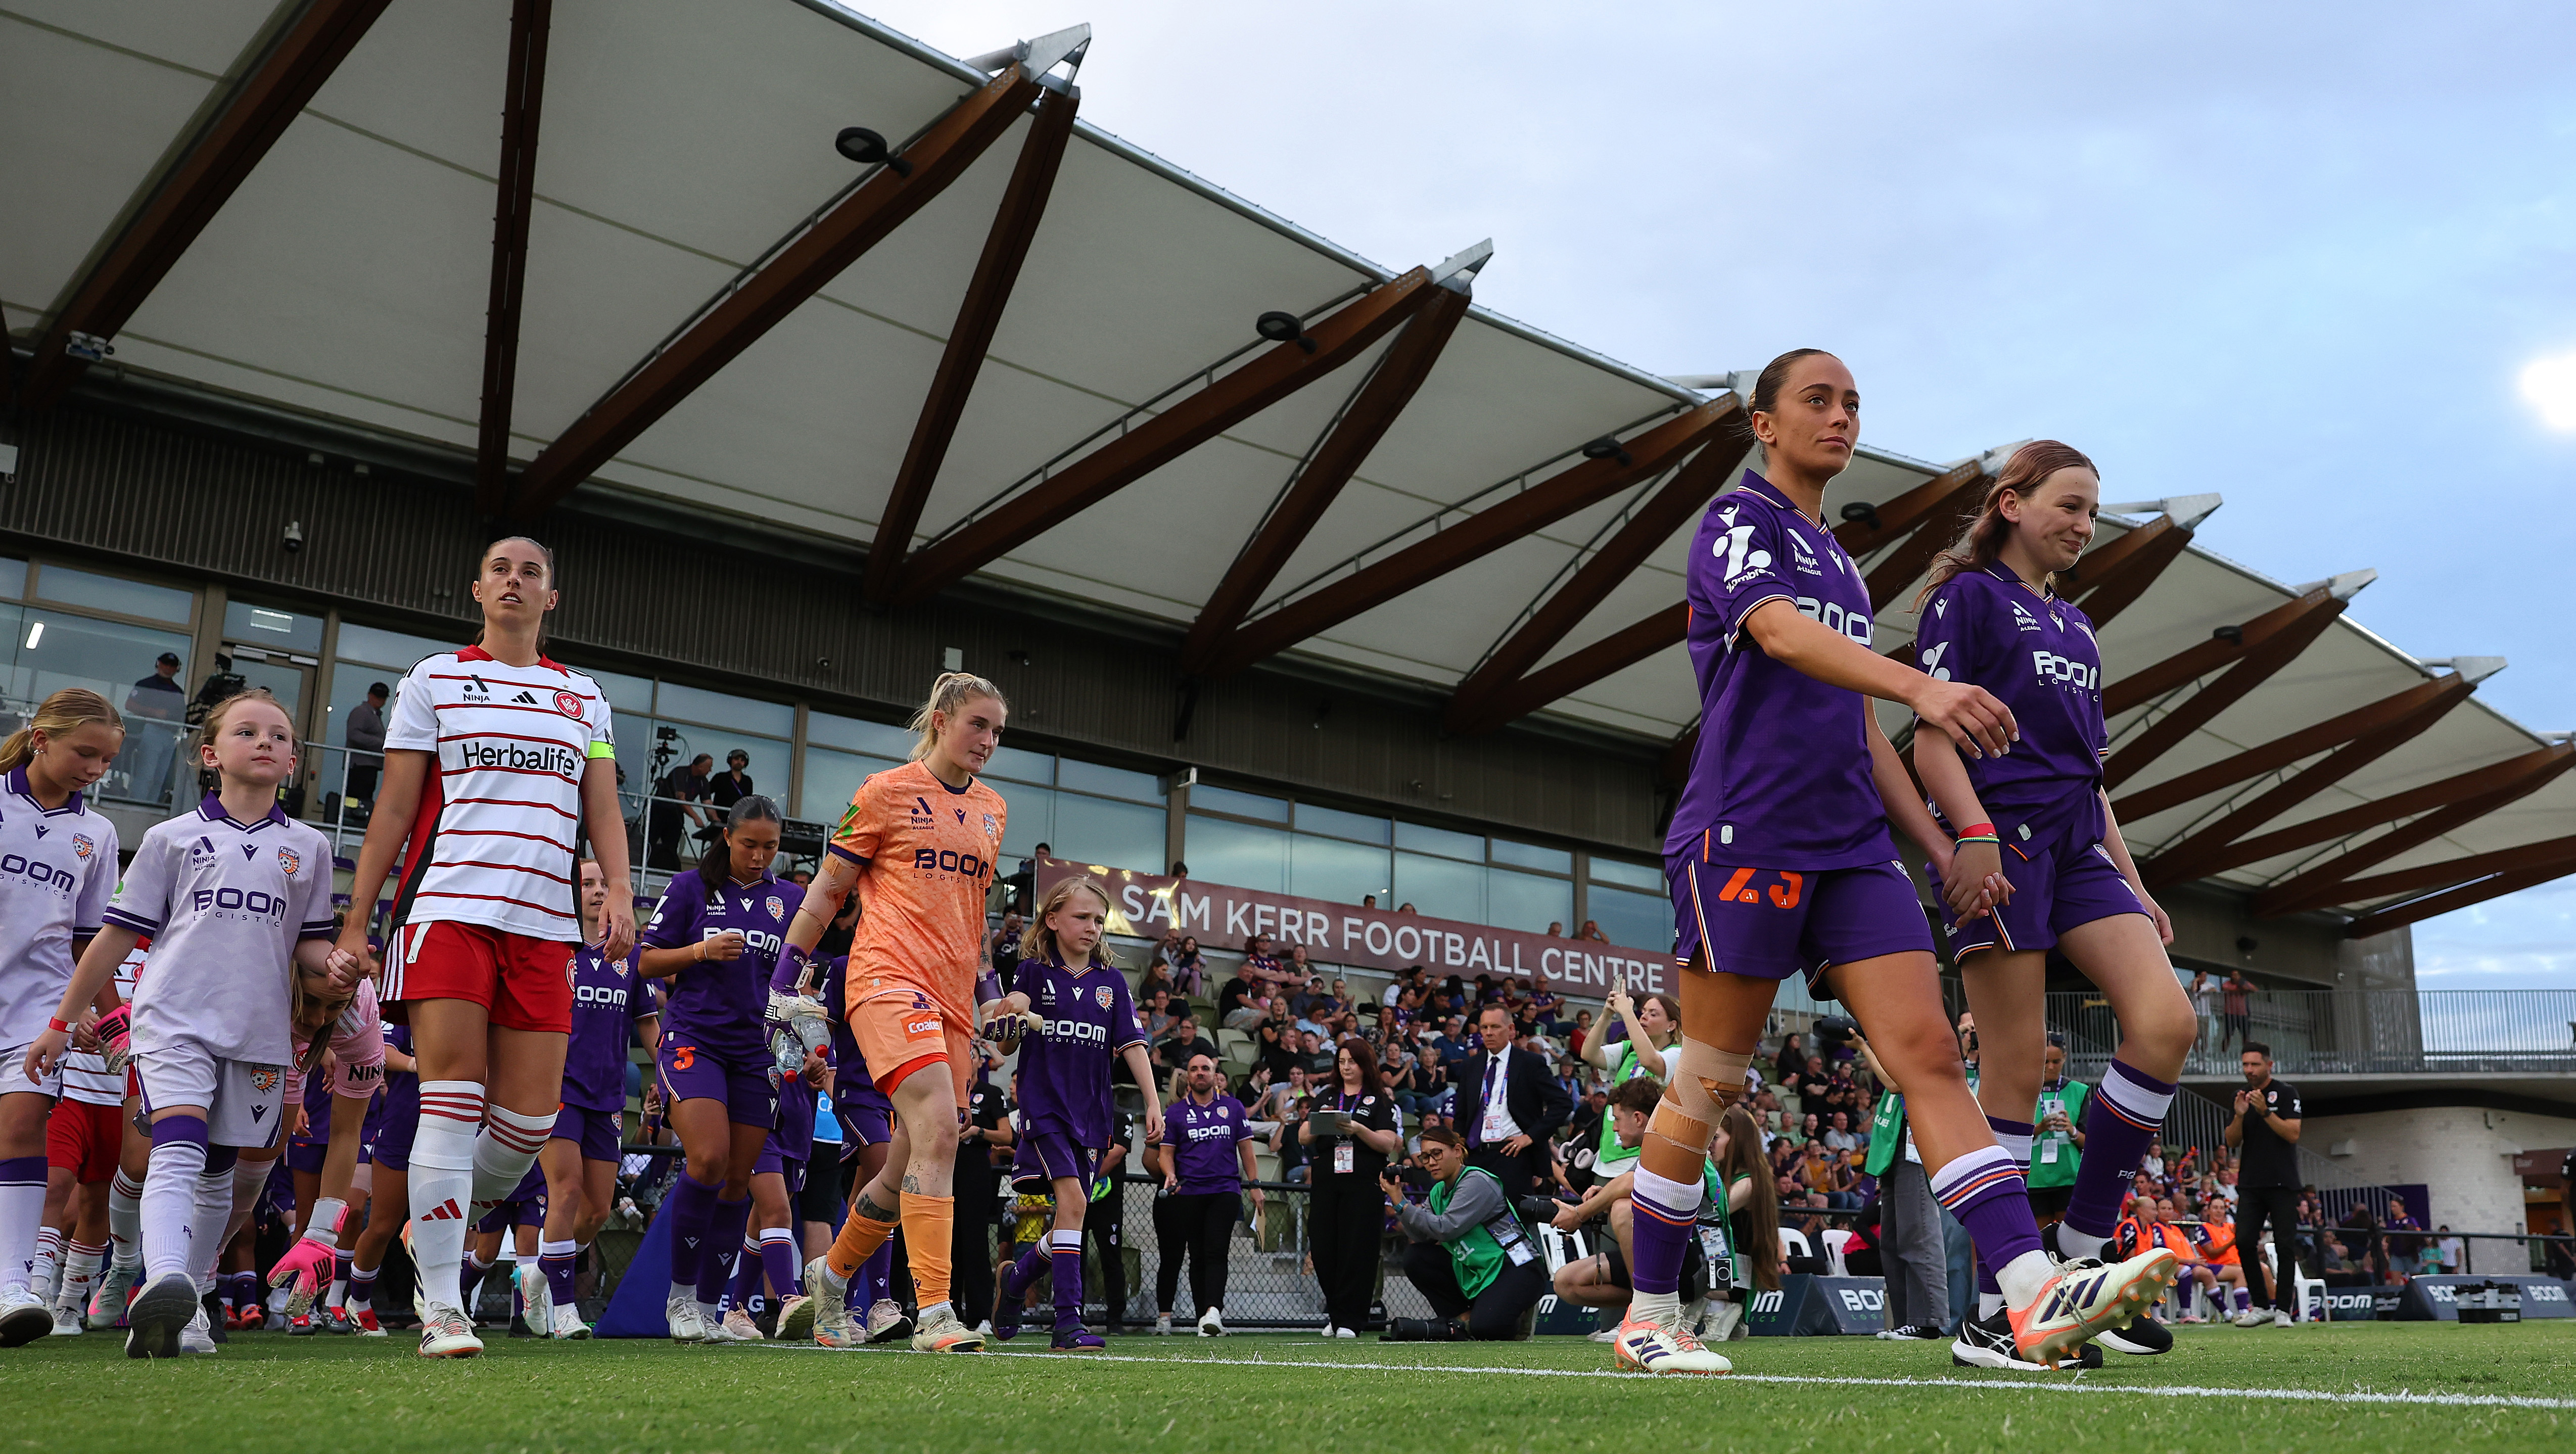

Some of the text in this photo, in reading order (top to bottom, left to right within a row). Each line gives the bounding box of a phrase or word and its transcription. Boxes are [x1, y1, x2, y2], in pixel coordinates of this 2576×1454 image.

[1797, 565, 1822, 577] A-LEAGUE
[2015, 617, 2038, 626] NINJA
[2038, 678, 2098, 702] LOISTIC
[463, 693, 491, 703] NINJA
[462, 742, 575, 776] Herbalife
[911, 816, 934, 825] NINJA
[192, 855, 216, 866] NINJA
[0, 854, 75, 893] OOM
[0, 874, 67, 900] GISTICS
[193, 887, 286, 921] BOOM
[193, 912, 280, 927] LOGISTIC
[1122, 884, 1665, 994] SAM KERR FOOTBALL CENTRE
[576, 985, 627, 1006] OOM
[577, 1002, 625, 1012] GISTICS
[908, 1019, 941, 1034] Coates
[1042, 1019, 1107, 1043] BOOM
[1048, 1038, 1104, 1050] OGISTICS
[1188, 1125, 1231, 1139] BOOM
[1454, 1240, 1476, 1262] 31
